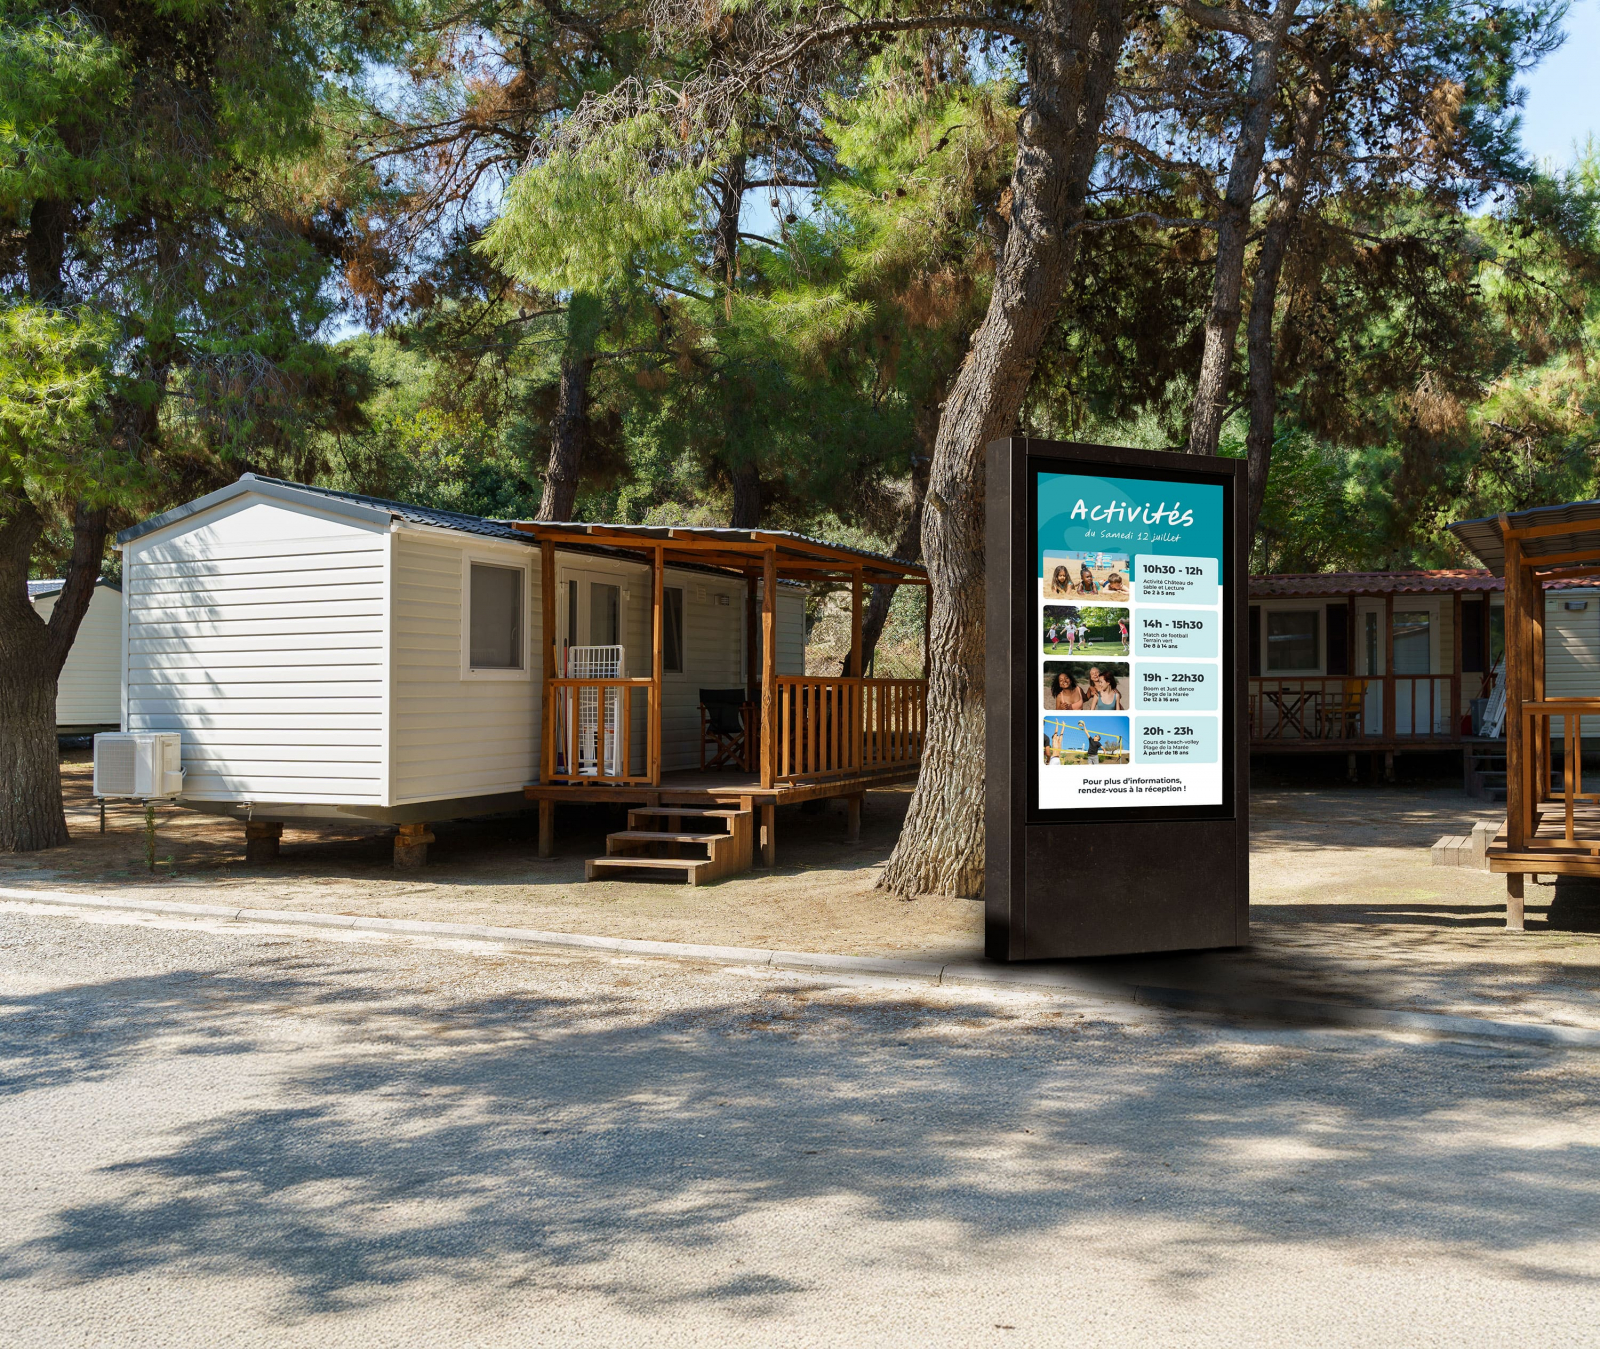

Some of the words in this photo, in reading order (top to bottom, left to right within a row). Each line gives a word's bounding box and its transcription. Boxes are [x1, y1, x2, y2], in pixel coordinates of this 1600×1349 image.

[1070, 499, 1193, 527] Activités
[1085, 529, 1095, 537] du
[1100, 530, 1133, 539] Samedi
[1151, 533, 1181, 542] juillet
[1143, 565, 1175, 574] 10h30
[1185, 567, 1203, 575] 12h
[1143, 620, 1162, 628] 14h
[1172, 620, 1203, 629] 15h30
[1143, 673, 1161, 681] 19h
[1172, 674, 1204, 682] 22h30
[1143, 727, 1164, 735] 20h
[1174, 727, 1193, 735] 23h
